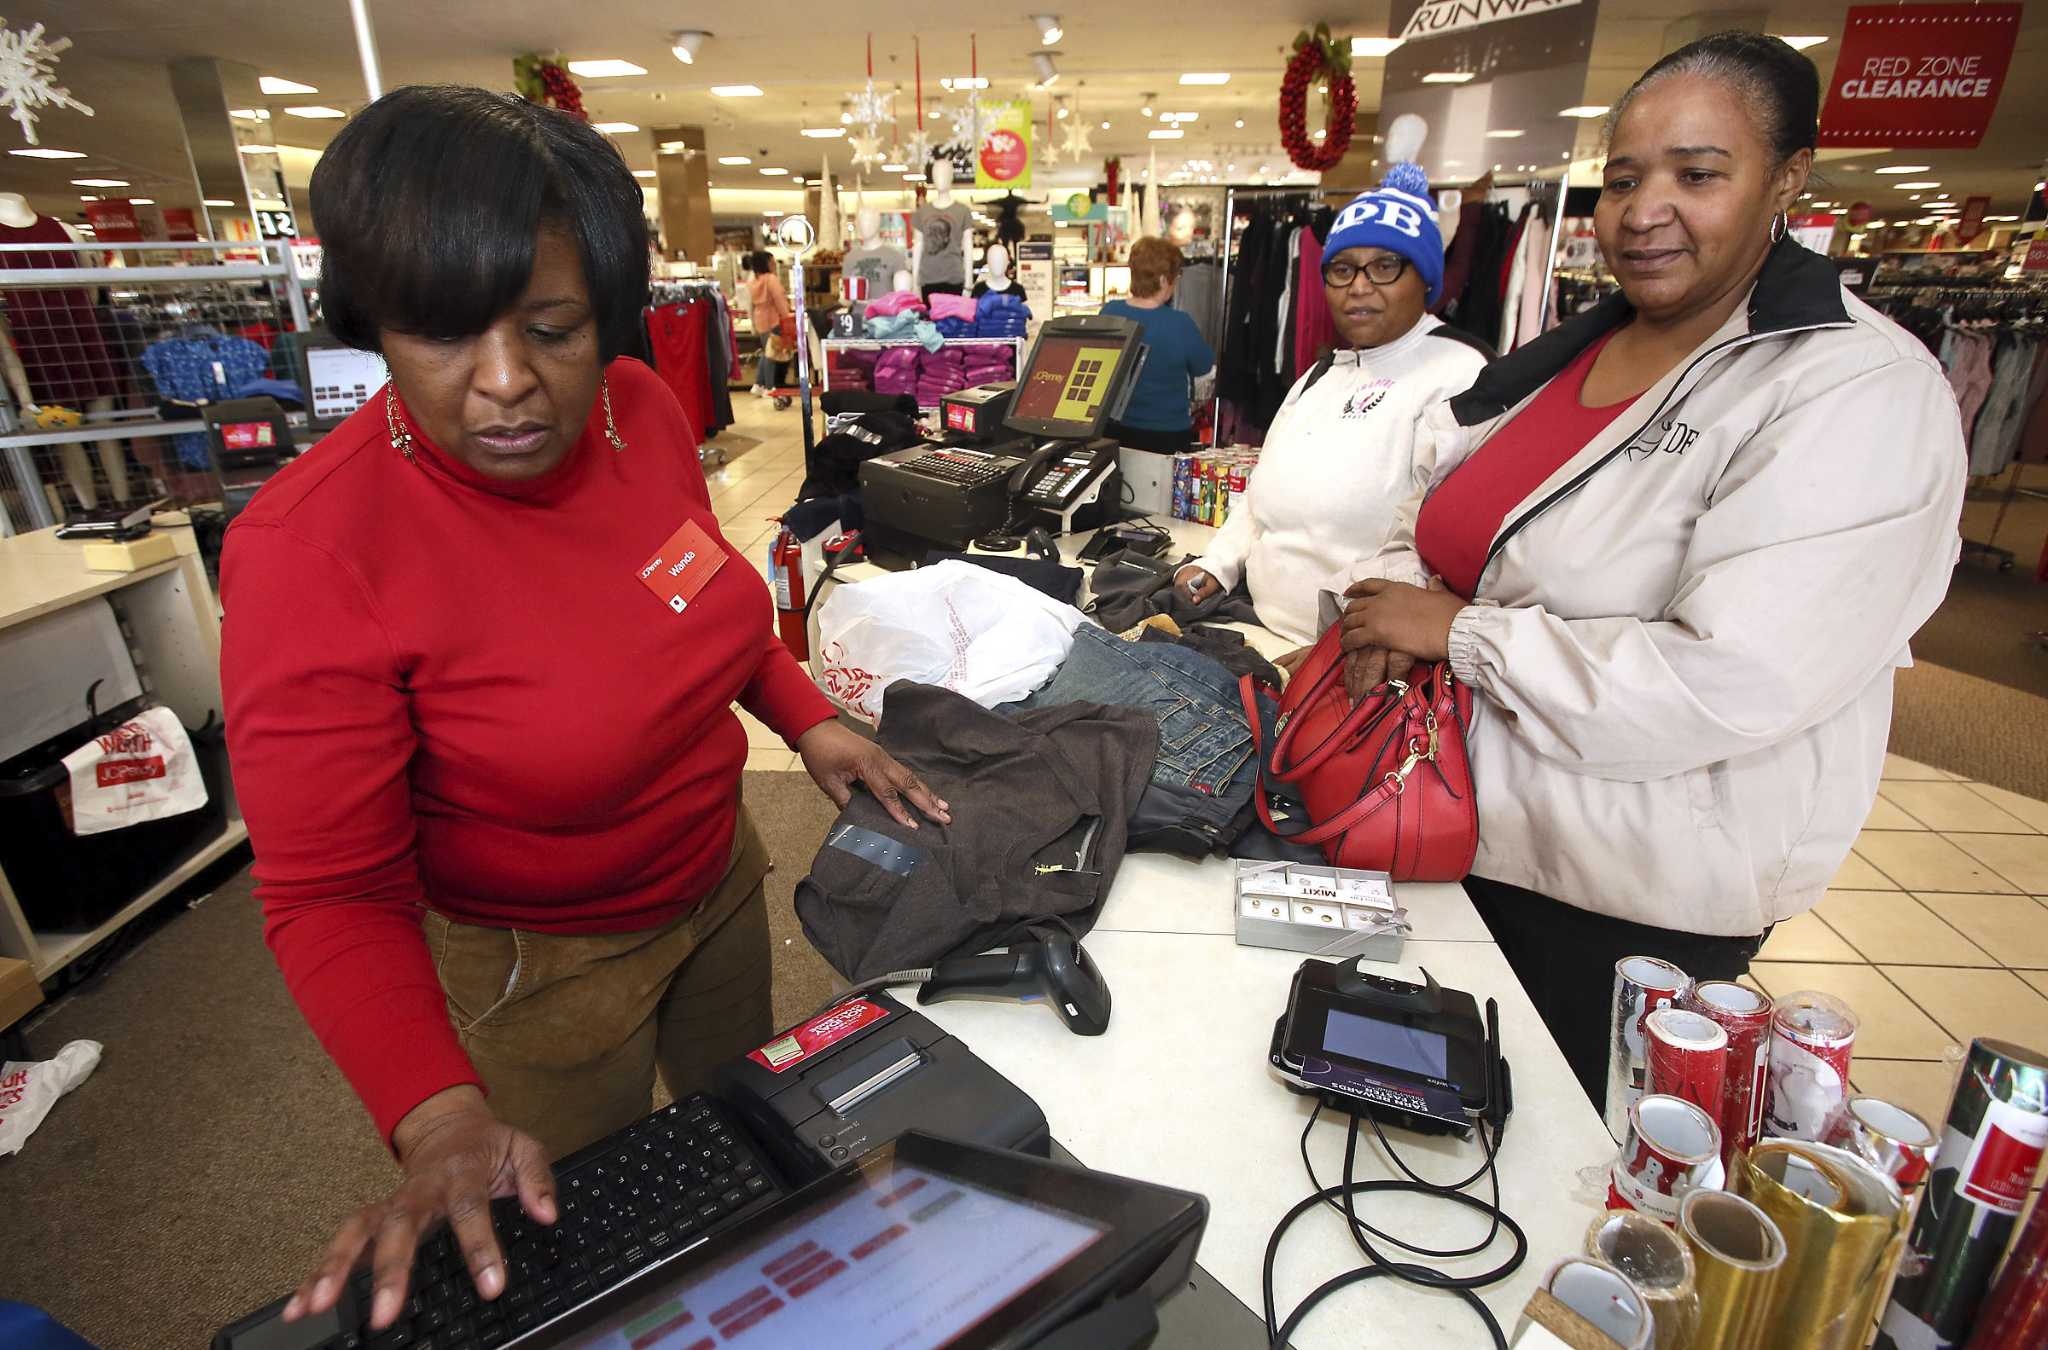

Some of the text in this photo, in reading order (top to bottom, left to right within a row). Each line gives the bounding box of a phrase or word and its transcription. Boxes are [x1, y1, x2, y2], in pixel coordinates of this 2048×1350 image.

[1408, 0, 1563, 33] RUNWA
[1863, 56, 1982, 76] RED ZONE
[1840, 78, 1992, 99] CLEARANCE
[840, 314, 854, 332] $9
[667, 550, 696, 577] Wanda
[1302, 886, 1337, 898] MIXIT
[815, 1005, 869, 1036] HOLIDAY
[1331, 1081, 1393, 1105] REWARDS
[1363, 1086, 1407, 1103] FASTER
[1394, 1096, 1429, 1112] EARN
